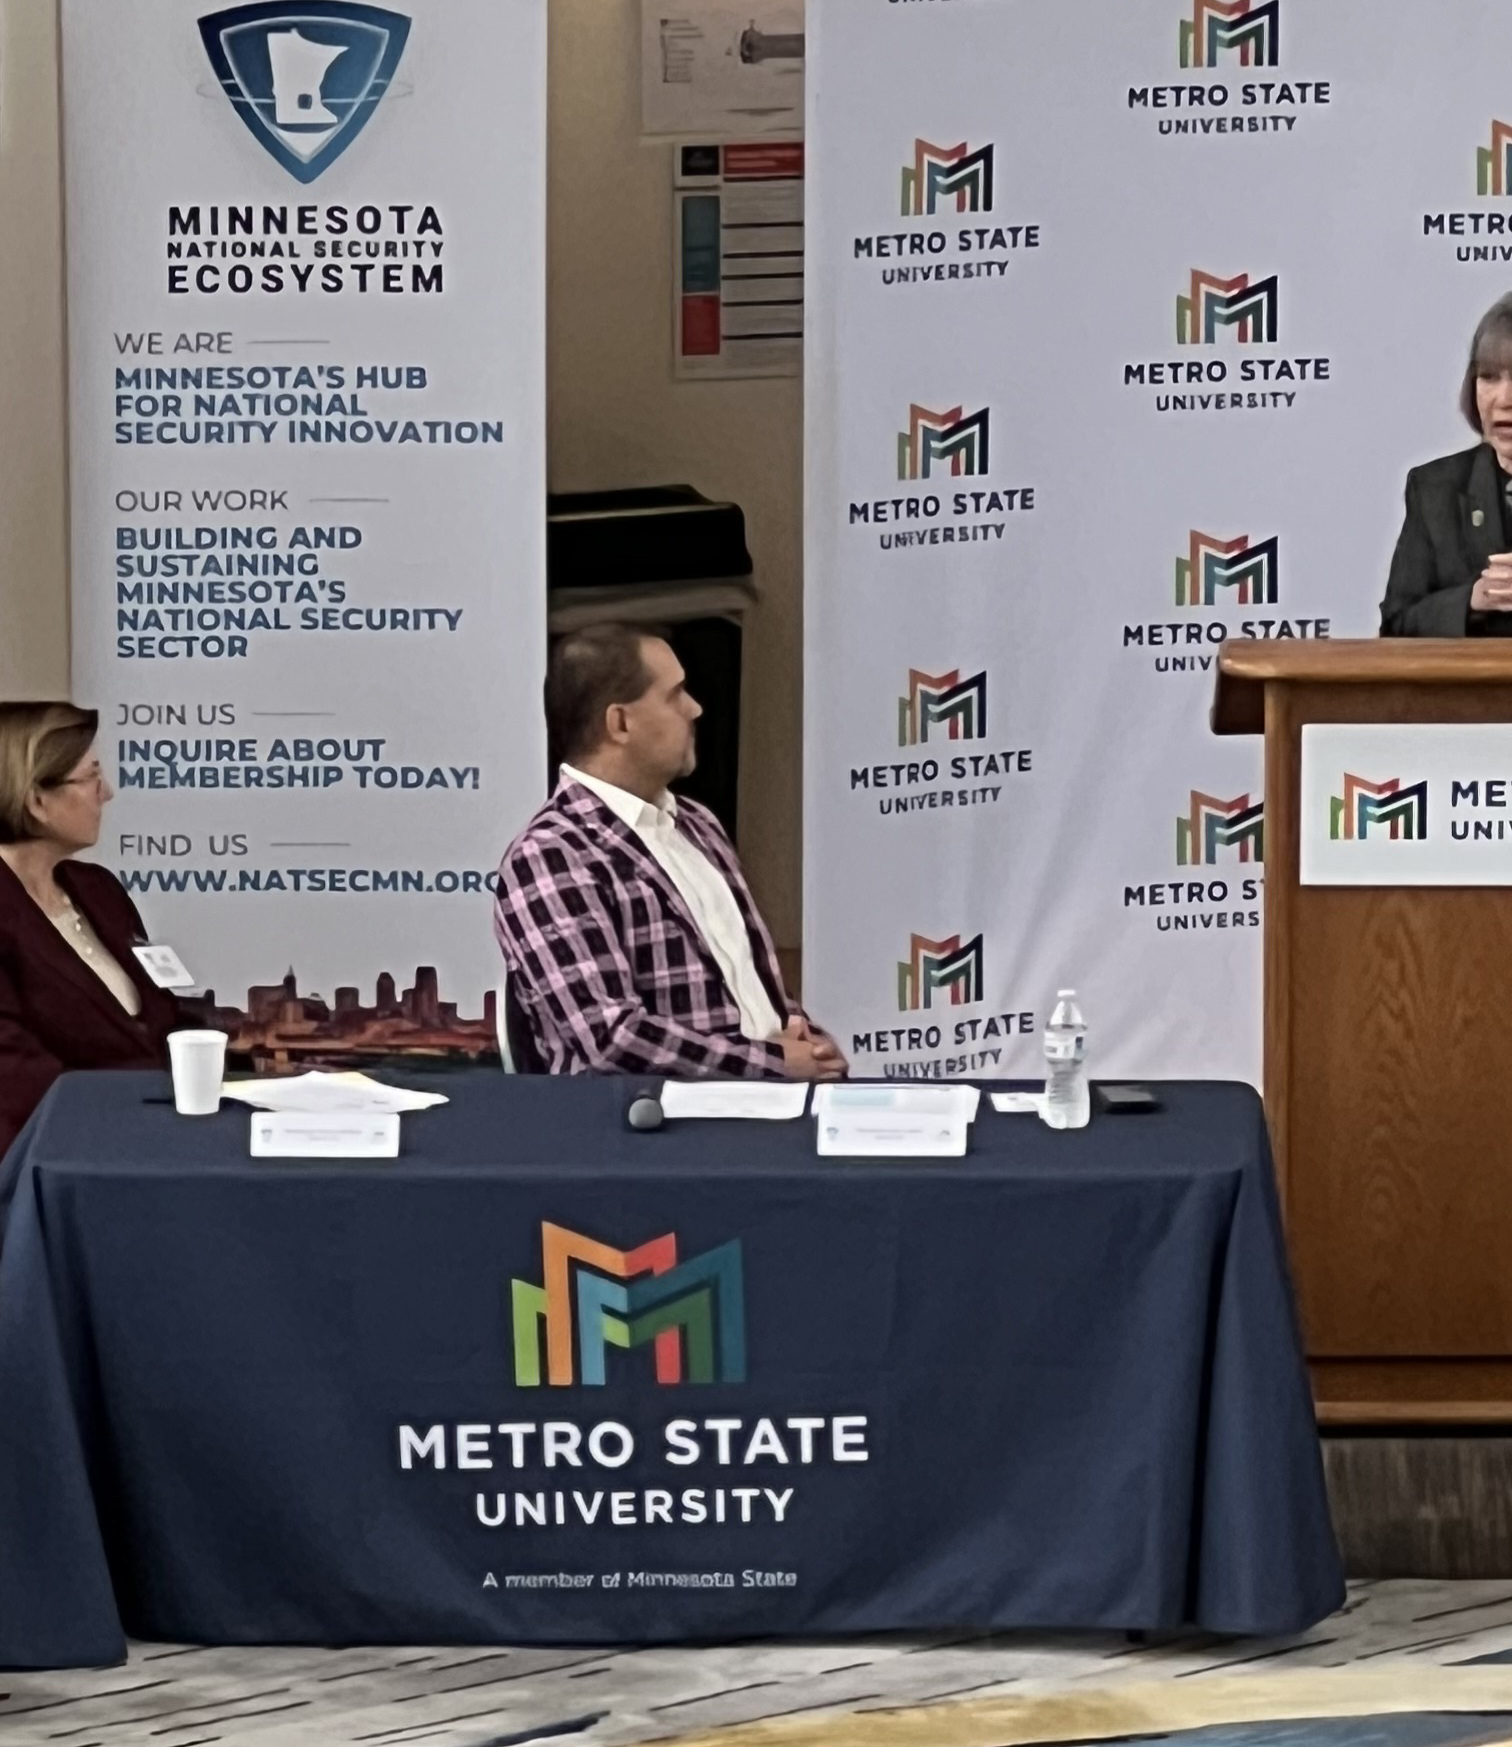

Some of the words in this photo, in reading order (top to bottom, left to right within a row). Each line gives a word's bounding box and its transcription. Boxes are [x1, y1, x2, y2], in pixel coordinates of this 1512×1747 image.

[1128, 84, 1229, 109] METRO
[1241, 81, 1331, 106] STATE
[1158, 115, 1297, 136] UNIVERSITY
[168, 205, 443, 236] MINNESOTA
[167, 240, 301, 259] NATIONAL
[313, 240, 444, 259] SECURITY
[854, 231, 947, 259] METRO
[958, 225, 1040, 252] STATE
[168, 263, 443, 294] ECOSYSTEM
[882, 260, 1009, 286] UNIVERSITY
[113, 332, 164, 355] WE
[173, 331, 233, 354] ARE
[115, 364, 345, 391] MINNESOTA'S
[356, 365, 428, 390] HUB
[1124, 360, 1227, 386] METRO
[1240, 358, 1330, 382] STATE
[115, 394, 182, 418] FOR
[194, 392, 368, 418] NATIONAL
[1156, 391, 1296, 412] UNIVERSITY
[115, 420, 278, 445] SECURITY
[288, 419, 503, 444] INNOVATION
[115, 489, 182, 513] OUR
[191, 488, 289, 512] WORK
[849, 495, 941, 525] METRO
[952, 487, 1035, 516] STATE
[116, 526, 278, 551] BUILDING
[288, 526, 362, 550] AND
[879, 523, 1006, 550] UNIVERSITY
[115, 553, 319, 578] SUSTAINING
[116, 579, 346, 605] MINNESOTA'S
[117, 607, 292, 632] NATIONAL
[300, 607, 464, 632] SECURITY
[116, 635, 248, 659] SECTOR
[1123, 622, 1228, 647] METRO
[116, 703, 187, 726] JOIN
[197, 703, 236, 726] US
[118, 738, 257, 767] INQUIRE
[266, 738, 387, 763] ABOUT
[118, 766, 344, 790] MEMBERSHIP
[351, 765, 480, 790] TODAY!
[850, 759, 939, 790] METRO
[950, 749, 1032, 779] STATE
[879, 786, 1002, 815] UNIVERSITY
[119, 834, 192, 857] FIND
[208, 833, 249, 856] US
[1124, 880, 1228, 907] METRO
[1157, 911, 1259, 931] UNIVERS
[852, 1025, 942, 1054] METRO
[954, 1011, 1035, 1046] STATE
[399, 1421, 634, 1470] METRO
[665, 1415, 869, 1465] STATE
[476, 1488, 794, 1527] UNIVERSITY
[483, 1572, 498, 1588] A
[742, 1570, 797, 1587] State
